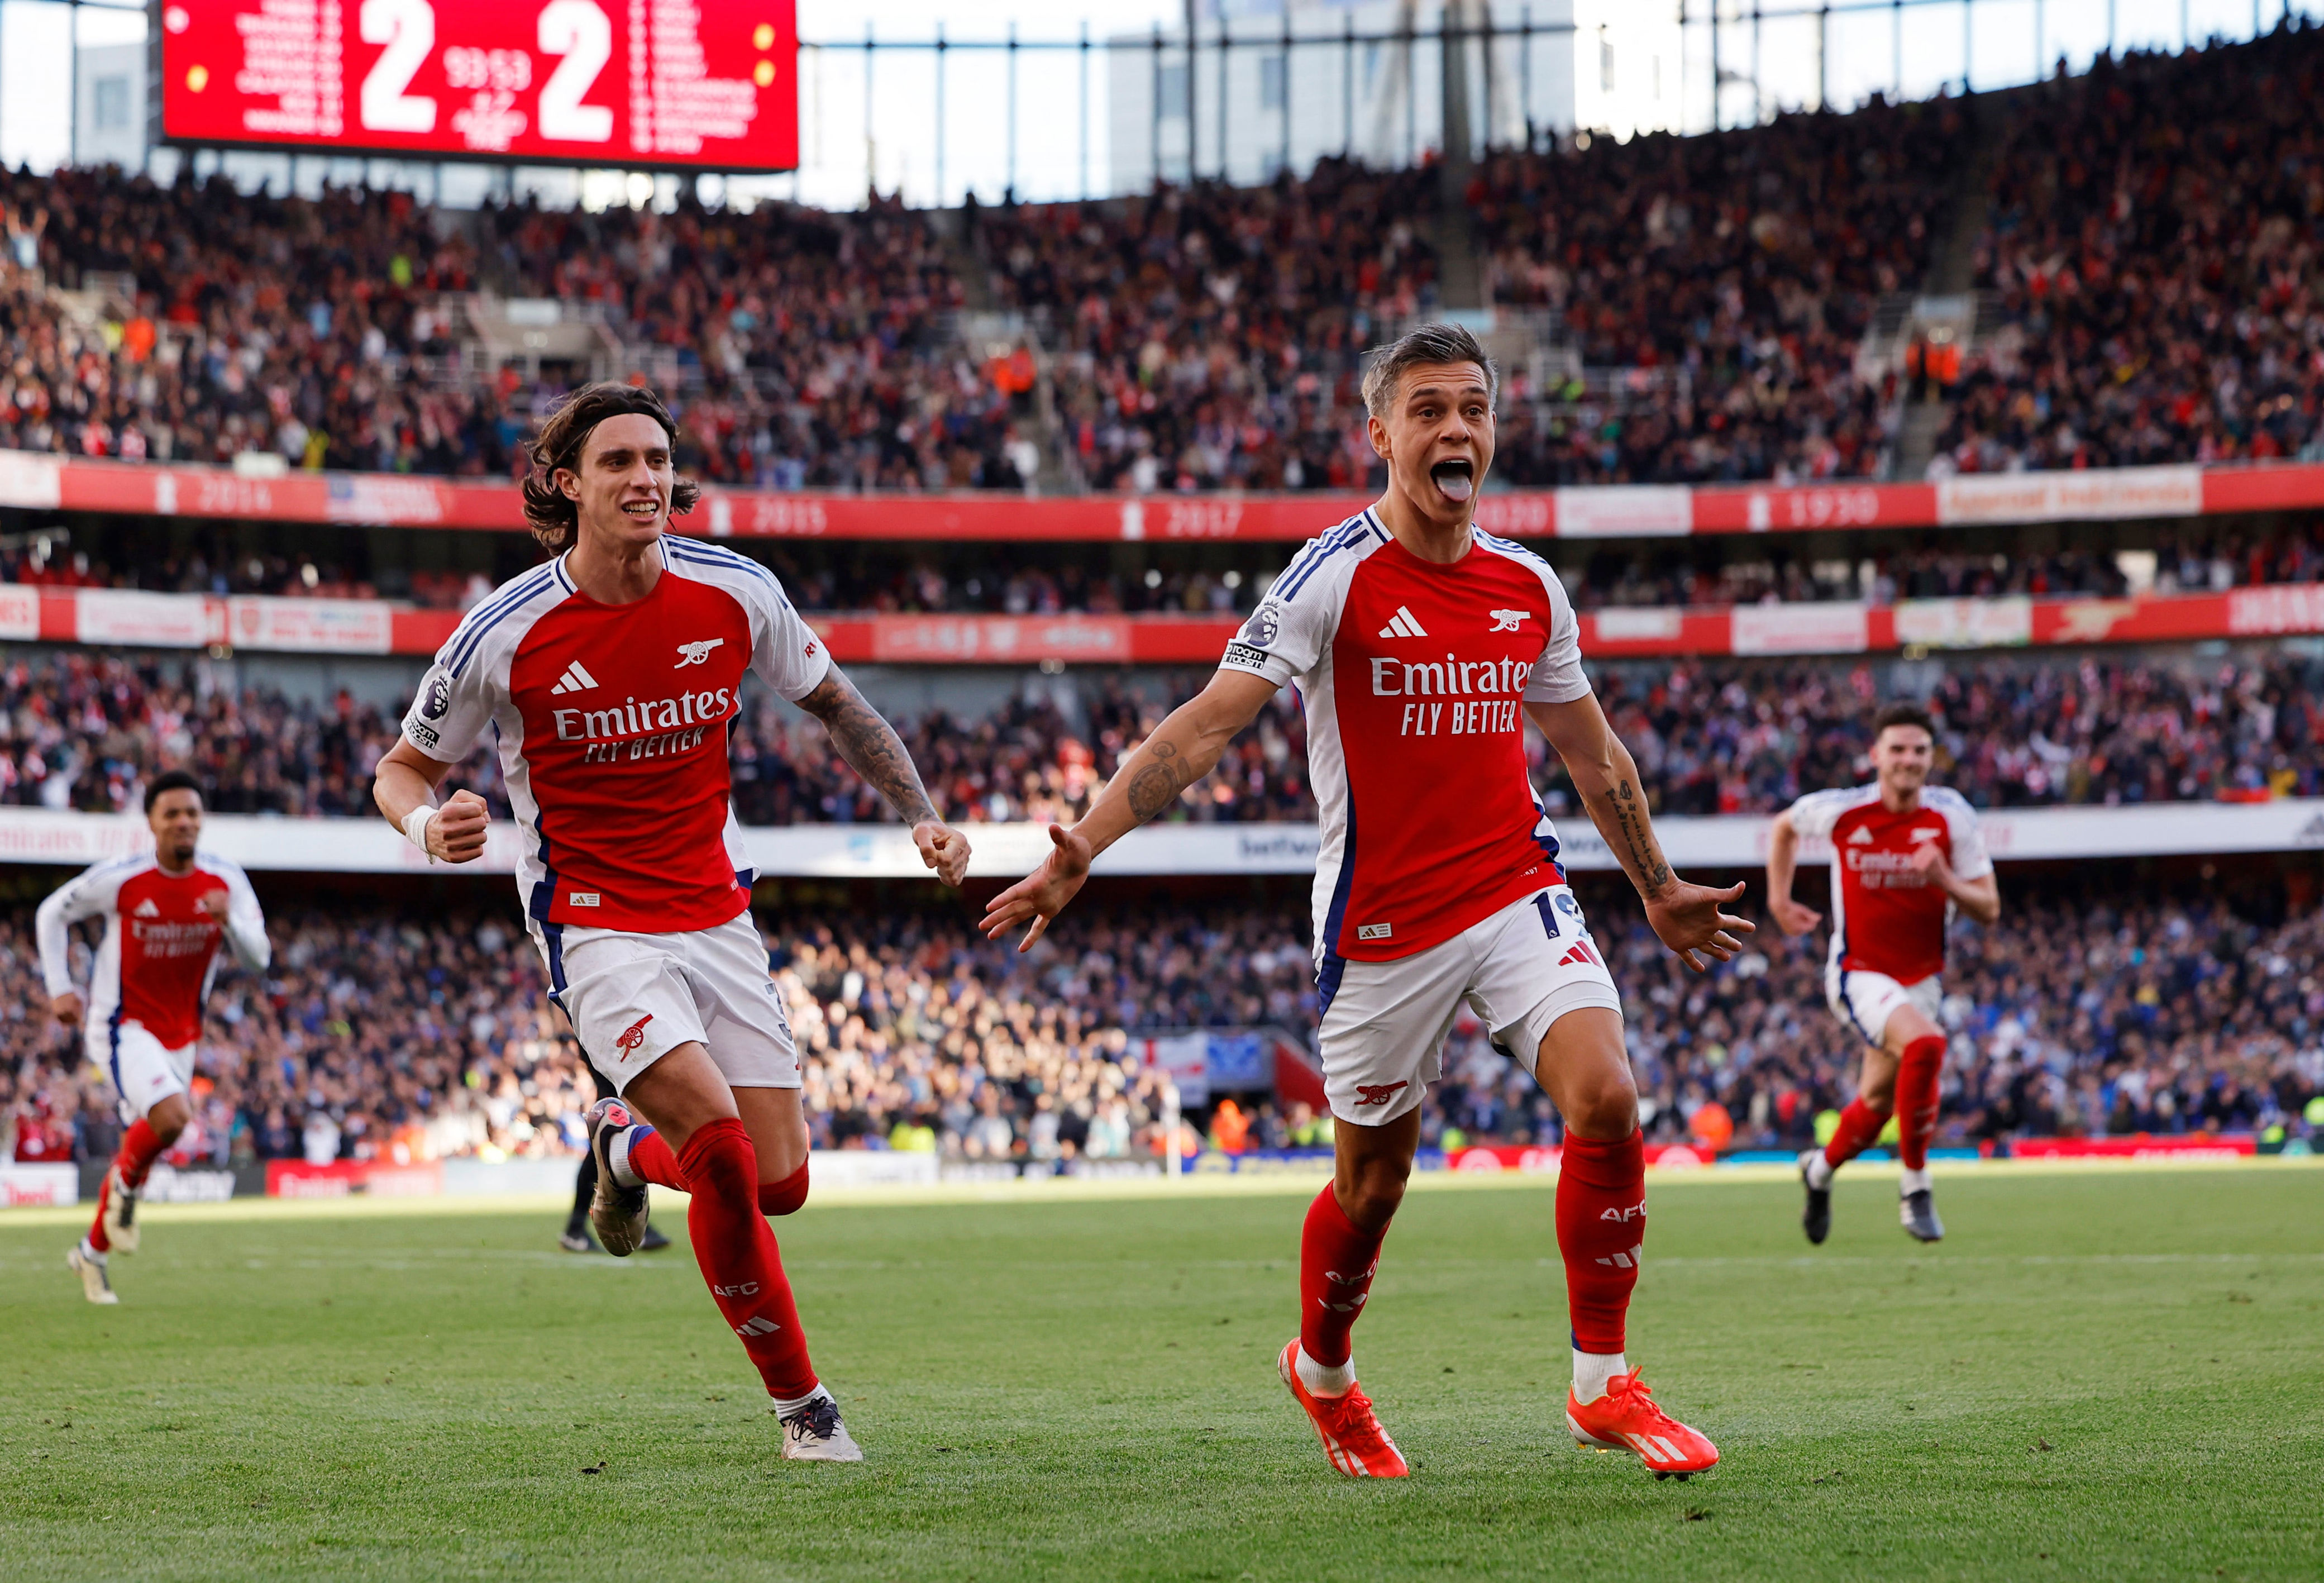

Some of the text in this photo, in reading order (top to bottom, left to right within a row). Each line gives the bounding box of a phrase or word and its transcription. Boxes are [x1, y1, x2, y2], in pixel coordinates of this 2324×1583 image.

[360, 0, 437, 133] 2
[537, 0, 614, 142] 2
[1229, 654, 1264, 669] racism
[1233, 644, 1262, 660] room
[552, 688, 729, 741] Emirates
[1401, 700, 1517, 736] FLY BETTER
[411, 727, 436, 749] racism
[584, 726, 706, 763] FLY BETTER
[714, 1281, 759, 1297] AFC
